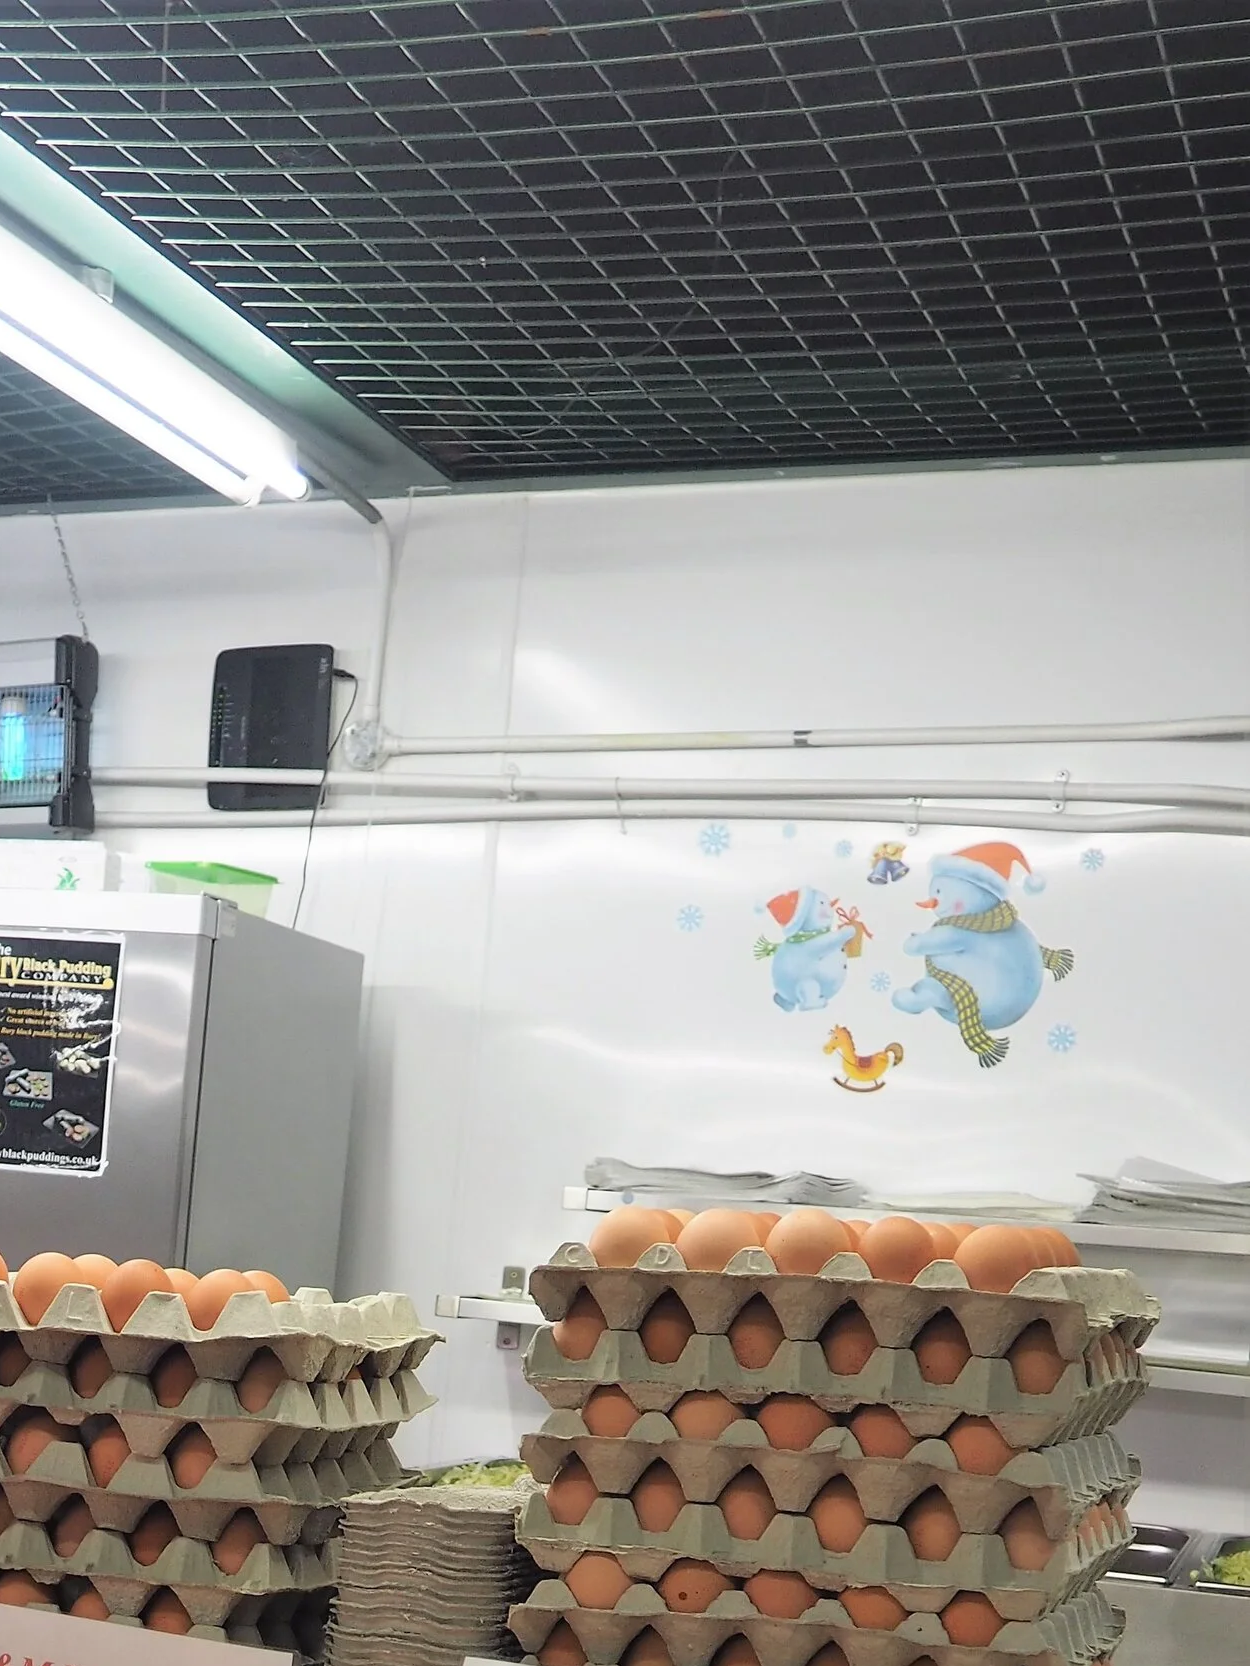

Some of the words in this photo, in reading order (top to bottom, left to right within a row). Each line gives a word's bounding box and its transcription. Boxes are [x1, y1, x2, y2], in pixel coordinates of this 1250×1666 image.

[21, 971, 103, 983] COMPANY
[23, 957, 56, 972] Black
[59, 960, 112, 978] Pudding
[564, 1244, 580, 1264] C
